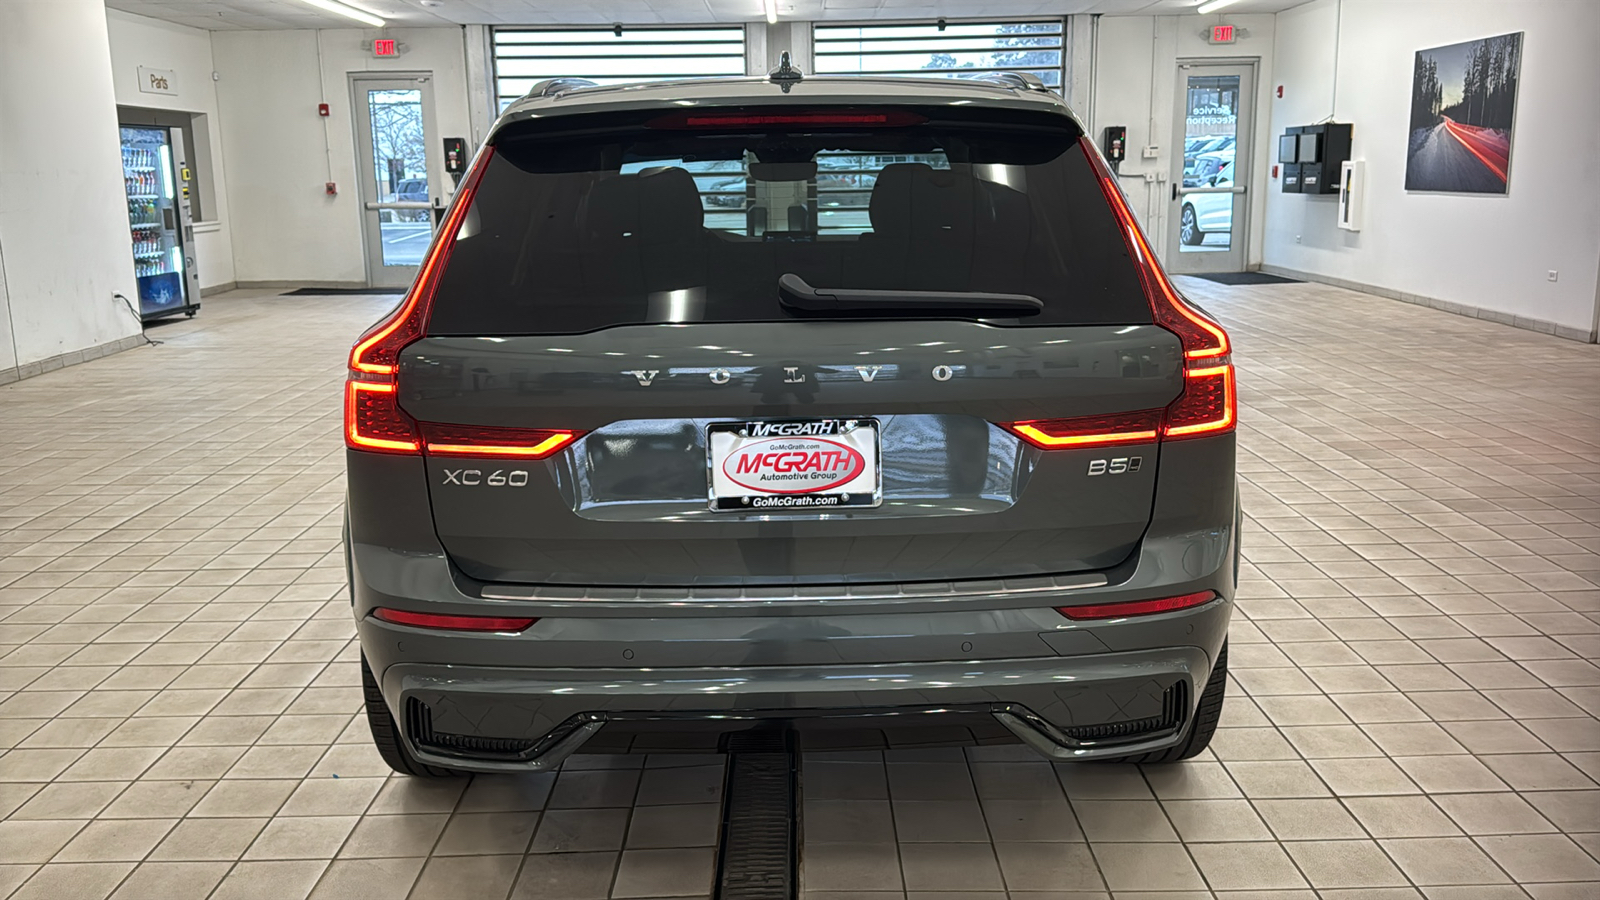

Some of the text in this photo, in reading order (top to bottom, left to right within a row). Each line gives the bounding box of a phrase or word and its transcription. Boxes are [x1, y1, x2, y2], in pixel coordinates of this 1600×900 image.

[1214, 25, 1233, 41] EXIT
[375, 39, 394, 55] EXIT
[150, 73, 168, 90] Parts
[630, 364, 953, 387] VOLVO
[769, 443, 820, 451] GoMcGrath.com
[760, 472, 838, 481] Automotive Group
[752, 496, 838, 508] GoMcGrath.com
